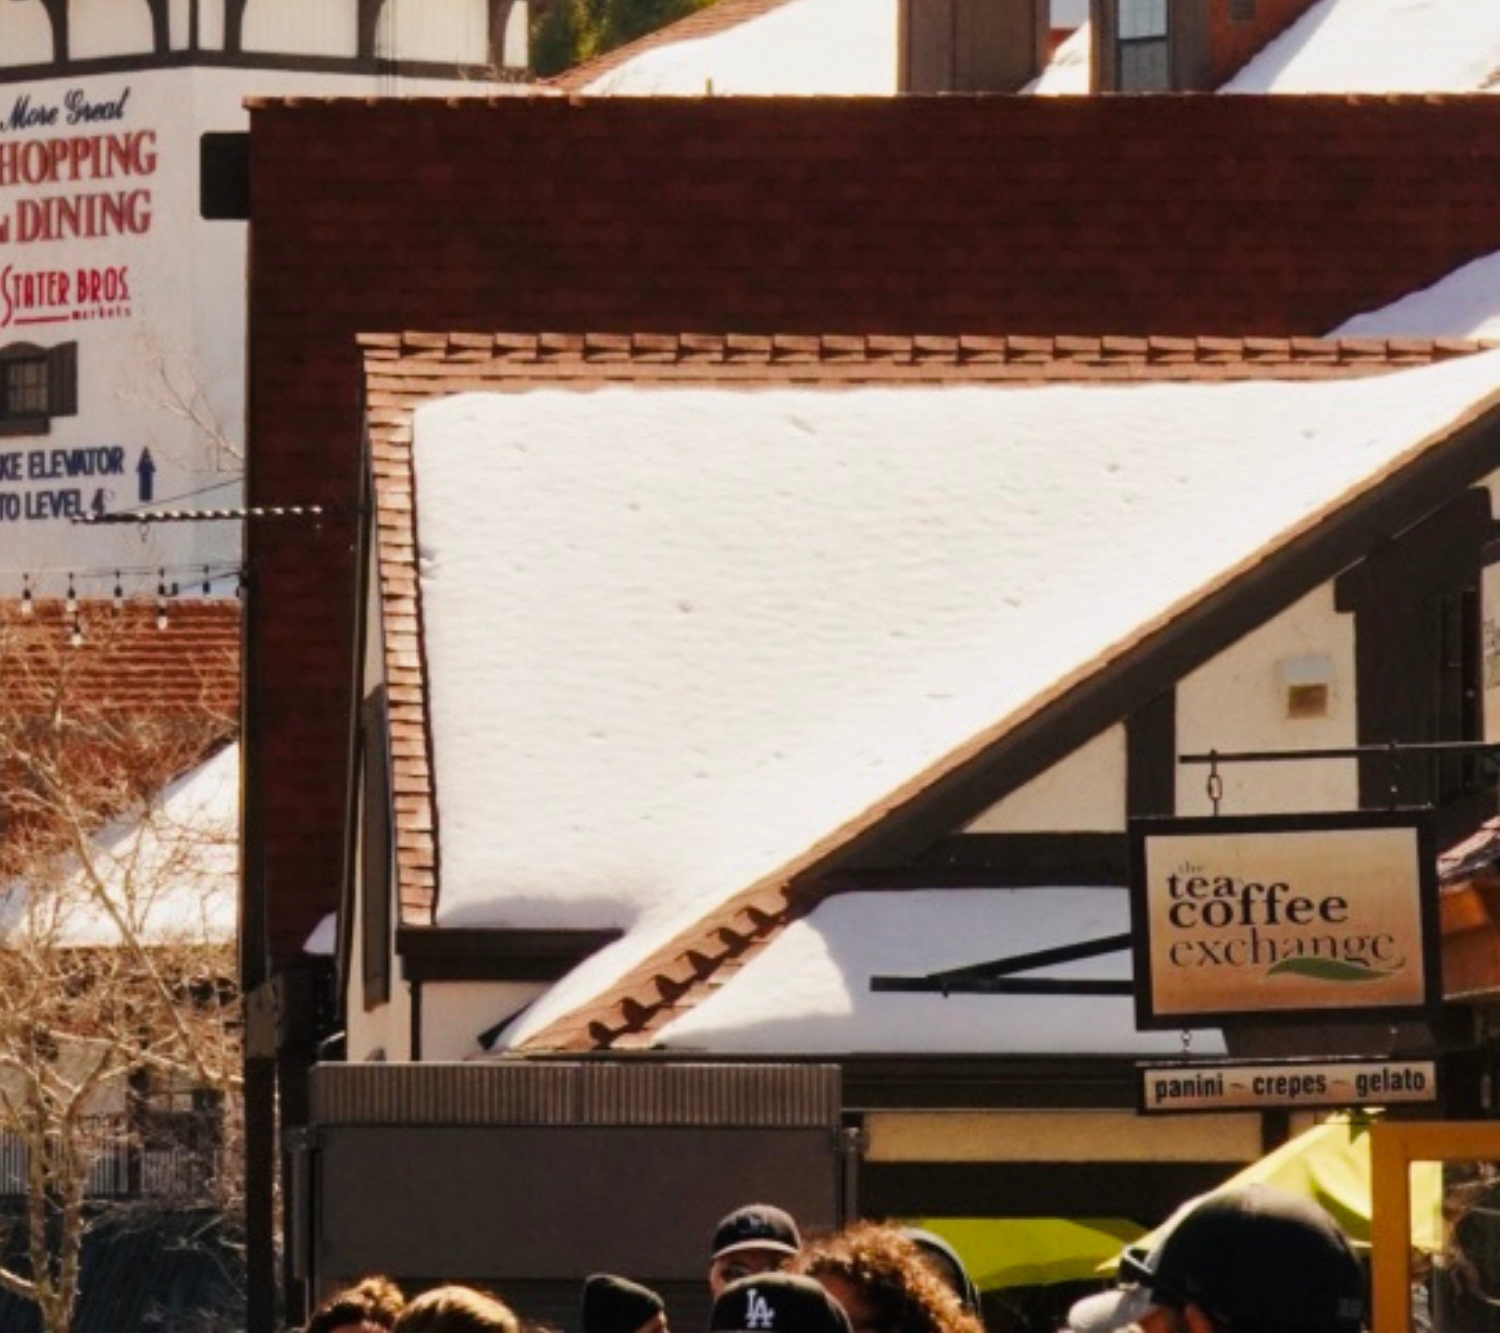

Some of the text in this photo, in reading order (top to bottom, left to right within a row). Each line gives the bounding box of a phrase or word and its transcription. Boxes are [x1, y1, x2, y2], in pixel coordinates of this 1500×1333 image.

[64, 87, 131, 124] Great
[16, 189, 152, 244] DINING
[0, 264, 70, 328] STATER
[28, 446, 124, 480] ELEVATOR
[25, 488, 86, 520] LEVEL
[1167, 873, 1238, 899] tea
[1168, 882, 1349, 929] coffee
[1169, 927, 1406, 970] exchange
[1155, 1068, 1426, 1103] panini crepes gelato
[745, 1288, 776, 1329] LA
